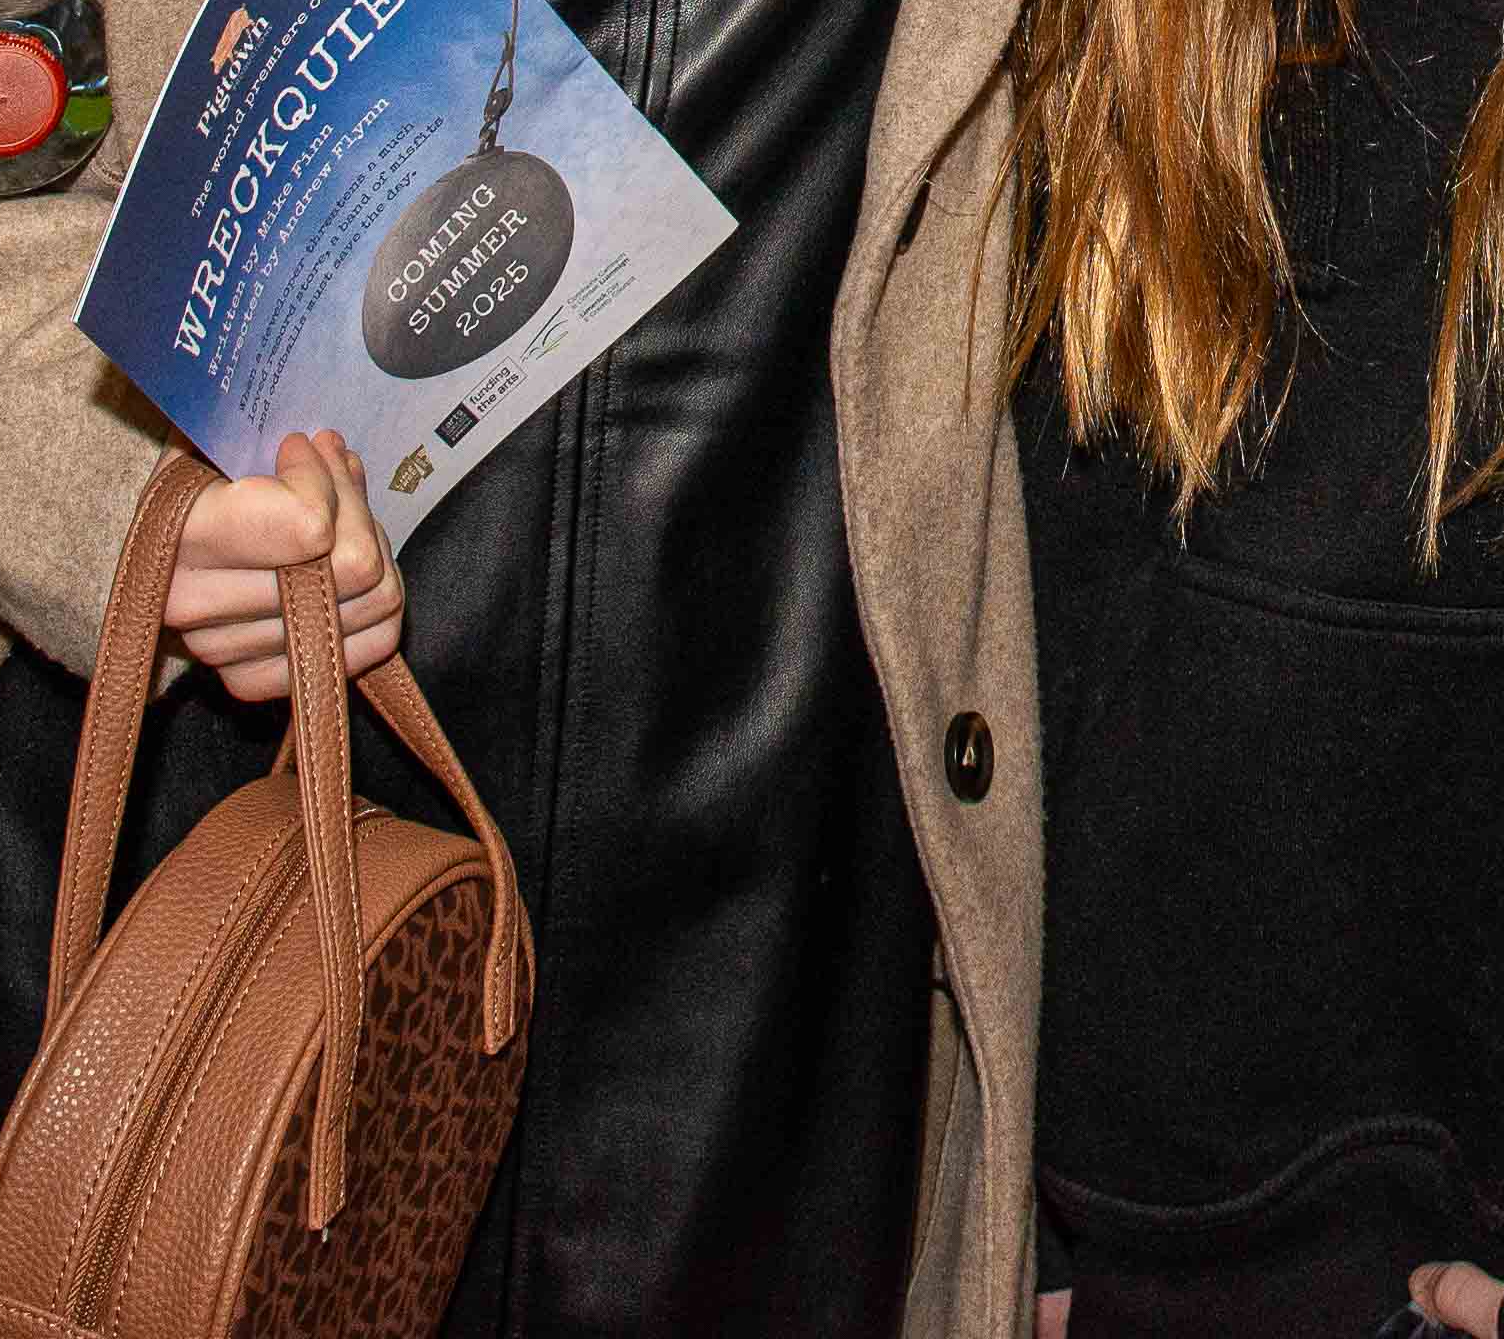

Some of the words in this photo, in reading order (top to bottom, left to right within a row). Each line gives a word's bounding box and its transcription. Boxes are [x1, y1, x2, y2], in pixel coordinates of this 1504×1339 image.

[191, 178, 212, 219] The
[211, 107, 246, 173] world
[245, 13, 308, 108] premiere
[196, 16, 271, 140] Pigtown
[208, 280, 245, 377] Written
[241, 243, 259, 274] by
[257, 181, 293, 241] Mike
[291, 123, 334, 179] Finn
[219, 280, 264, 395] Directed
[261, 245, 281, 277] by
[278, 161, 333, 245] Andrew
[331, 98, 390, 161] Flynn
[239, 366, 257, 411] When
[261, 256, 306, 348] developer
[305, 173, 366, 255] threatens
[377, 122, 415, 160] much
[248, 369, 269, 425] loved
[266, 303, 297, 366] record
[338, 193, 372, 233] band
[371, 170, 389, 193] of
[389, 115, 445, 174] misfits
[258, 401, 272, 435] and
[269, 314, 308, 396] oddballs
[307, 271, 334, 314] must
[333, 232, 362, 271] save
[359, 202, 385, 231] the
[387, 183, 497, 302] COMING
[408, 208, 528, 335] SUMMER
[455, 259, 529, 337] 2025
[468, 366, 511, 407] funding
[476, 392, 497, 415] the
[496, 371, 520, 396] arts
